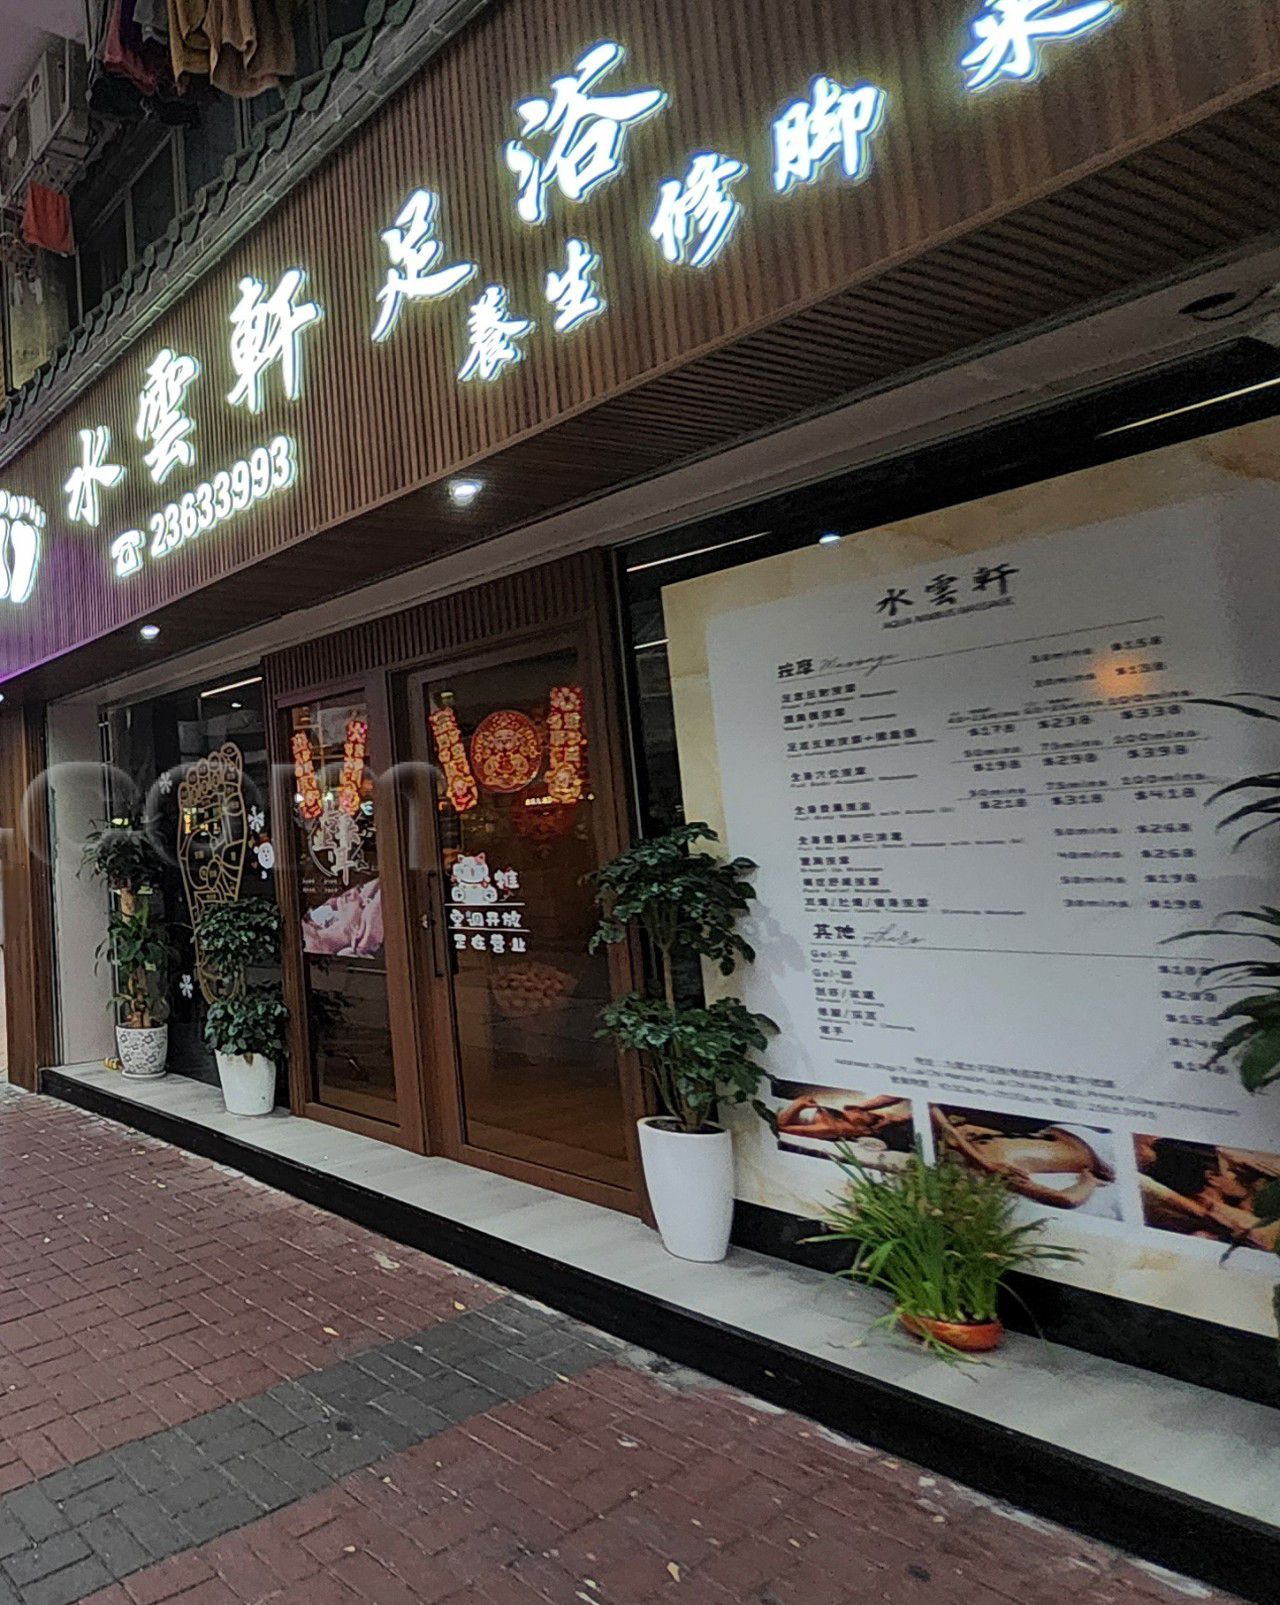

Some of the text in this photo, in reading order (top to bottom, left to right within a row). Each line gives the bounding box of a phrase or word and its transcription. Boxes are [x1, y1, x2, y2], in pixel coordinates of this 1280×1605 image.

[65, 267, 322, 527] 水雲軒
[150, 436, 295, 558] 23633993
[876, 563, 1019, 616] 水雲軒
[813, 923, 856, 940] 其他
